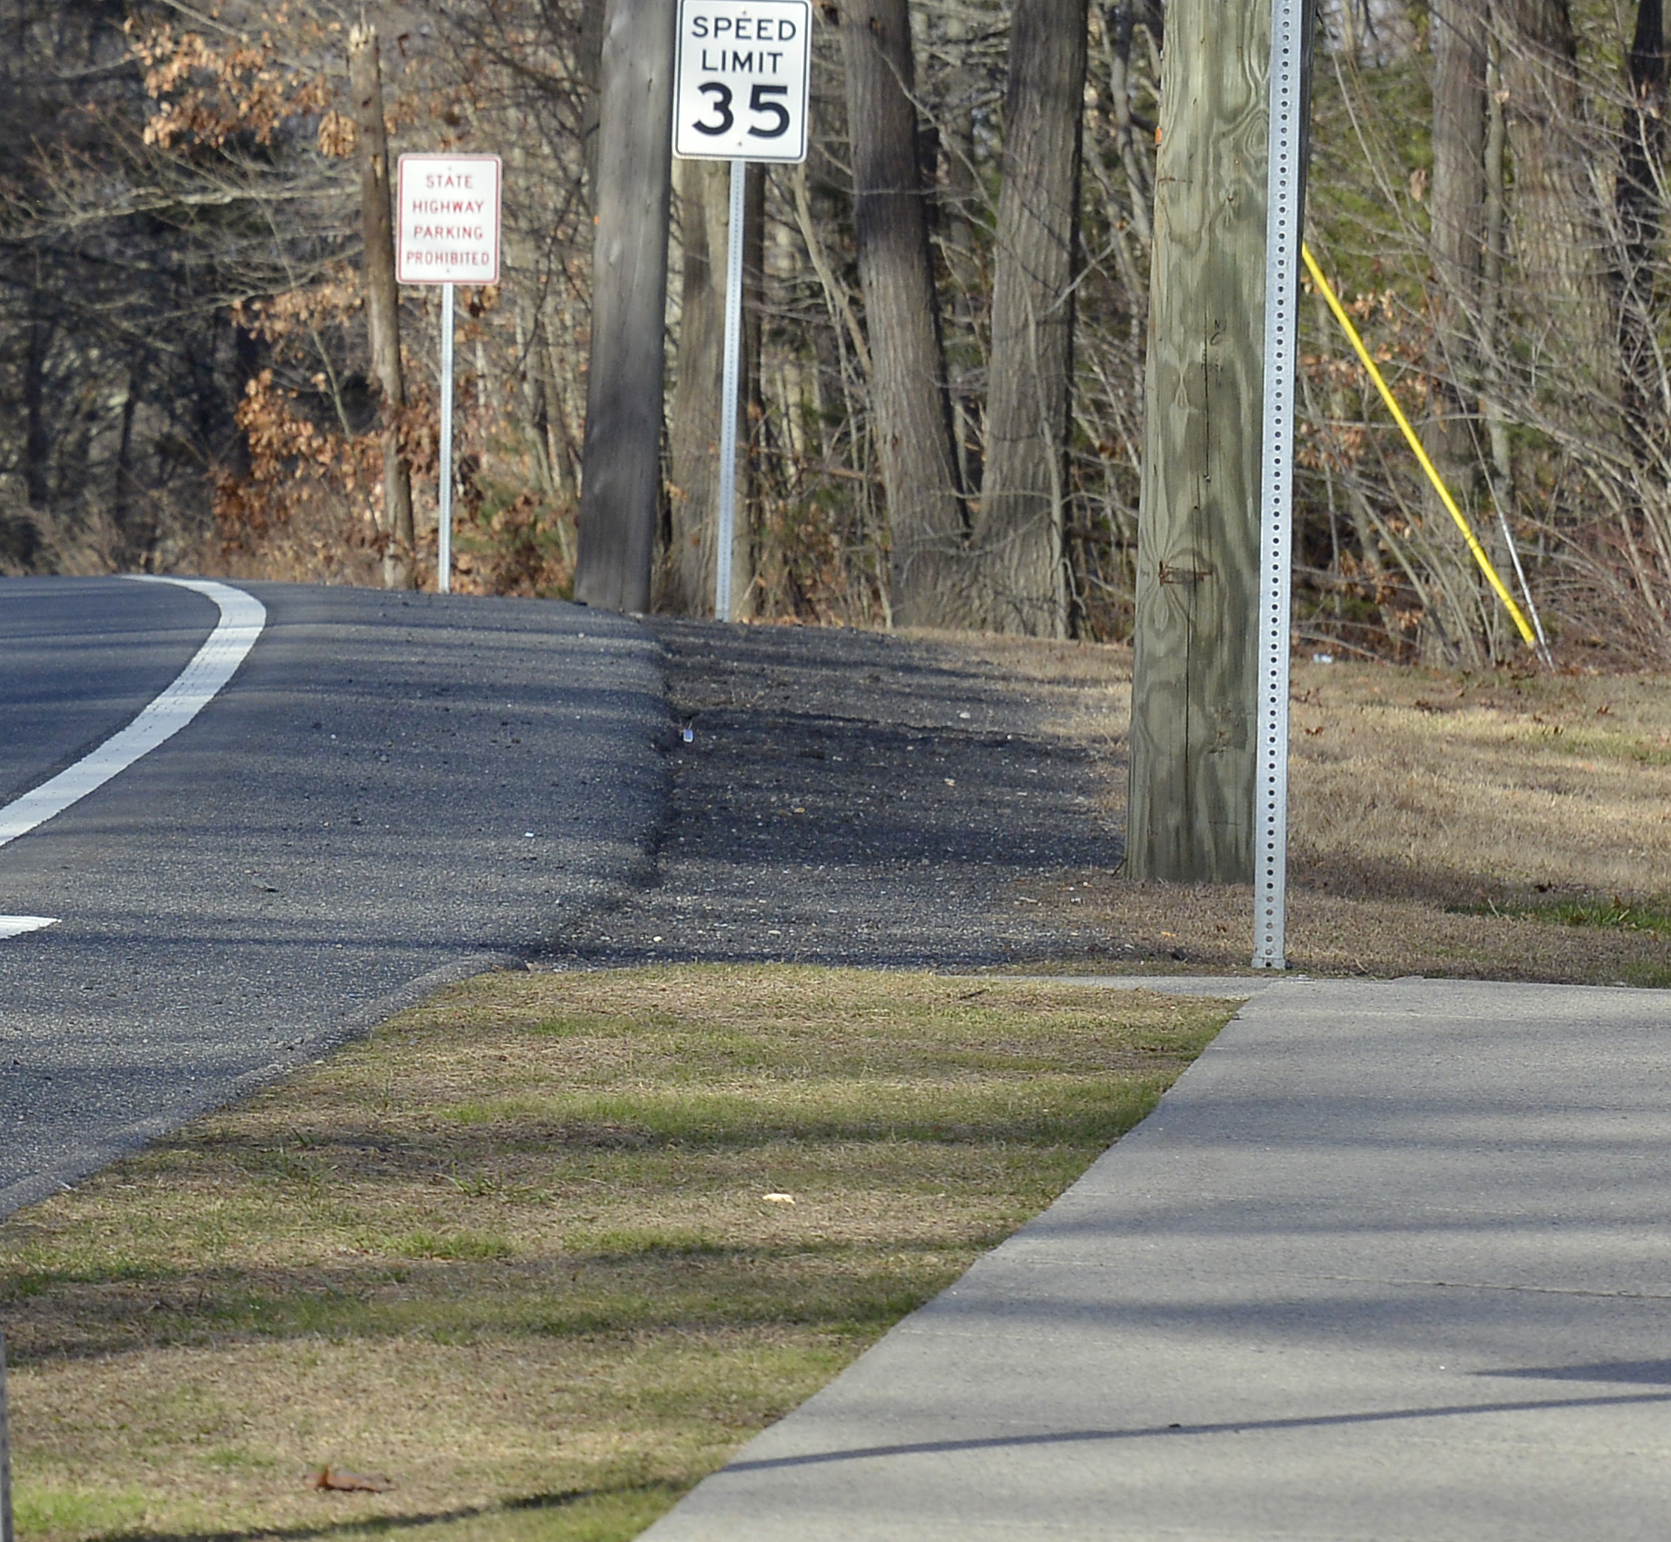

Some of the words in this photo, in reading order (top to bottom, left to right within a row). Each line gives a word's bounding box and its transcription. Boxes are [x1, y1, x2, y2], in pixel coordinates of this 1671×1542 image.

[692, 16, 797, 41] SPEED
[701, 49, 783, 74] LIMIT
[692, 81, 790, 140] 35
[426, 175, 473, 189] STATE
[412, 200, 485, 214] HIGHWAY
[413, 225, 483, 240] PARKING
[406, 251, 490, 266] PROHIBITED
